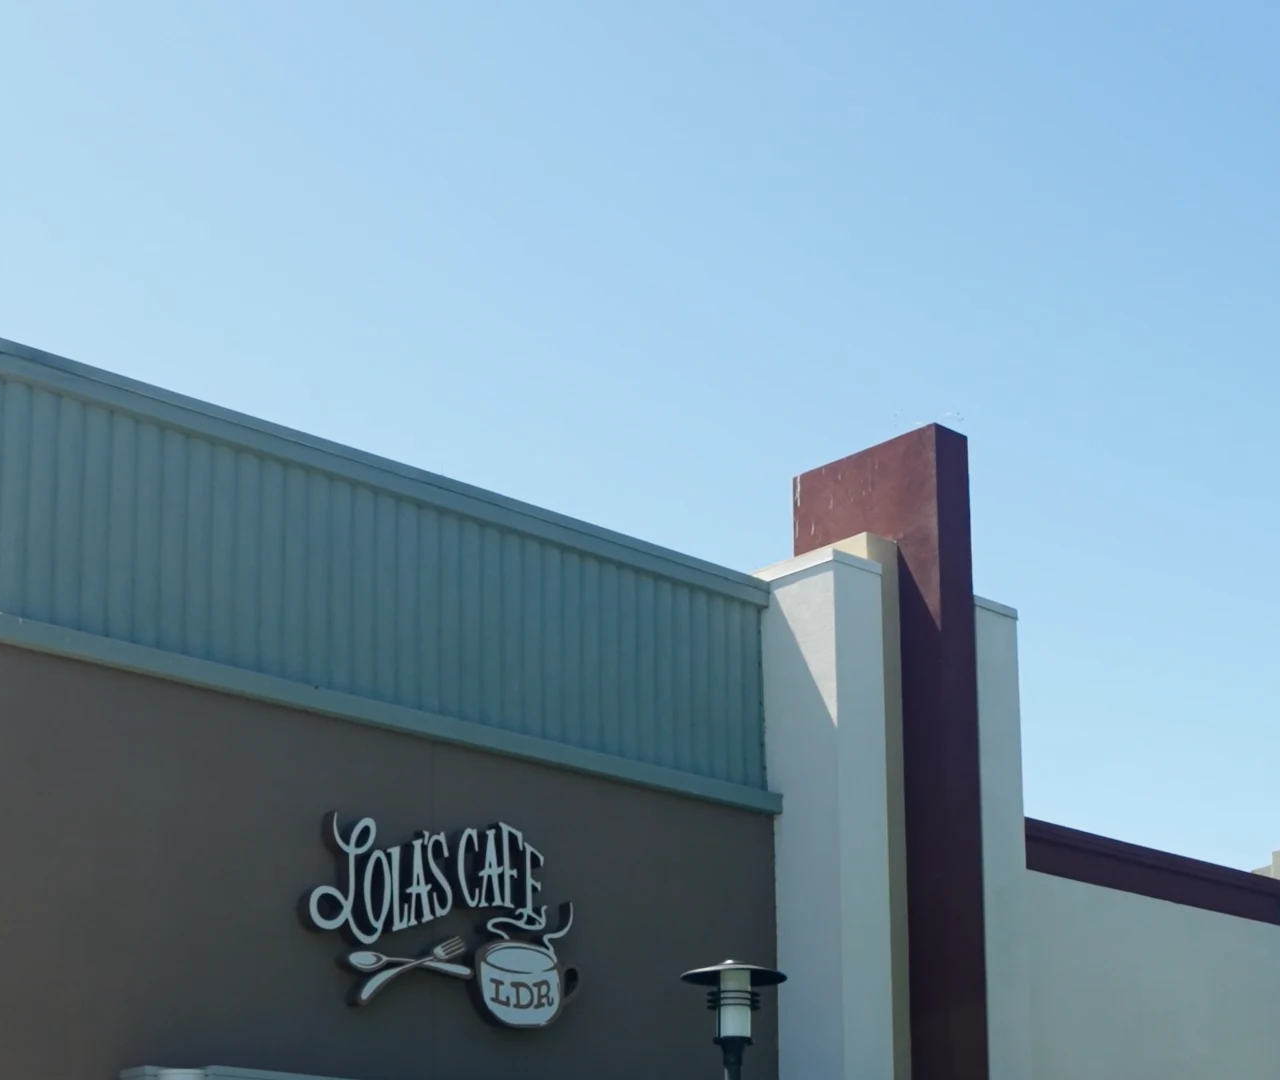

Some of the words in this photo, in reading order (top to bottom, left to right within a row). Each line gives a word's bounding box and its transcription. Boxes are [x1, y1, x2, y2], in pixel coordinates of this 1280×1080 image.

[309, 811, 453, 945] LOLA'S
[457, 821, 547, 917] CAFE
[489, 976, 554, 1010] LDR
